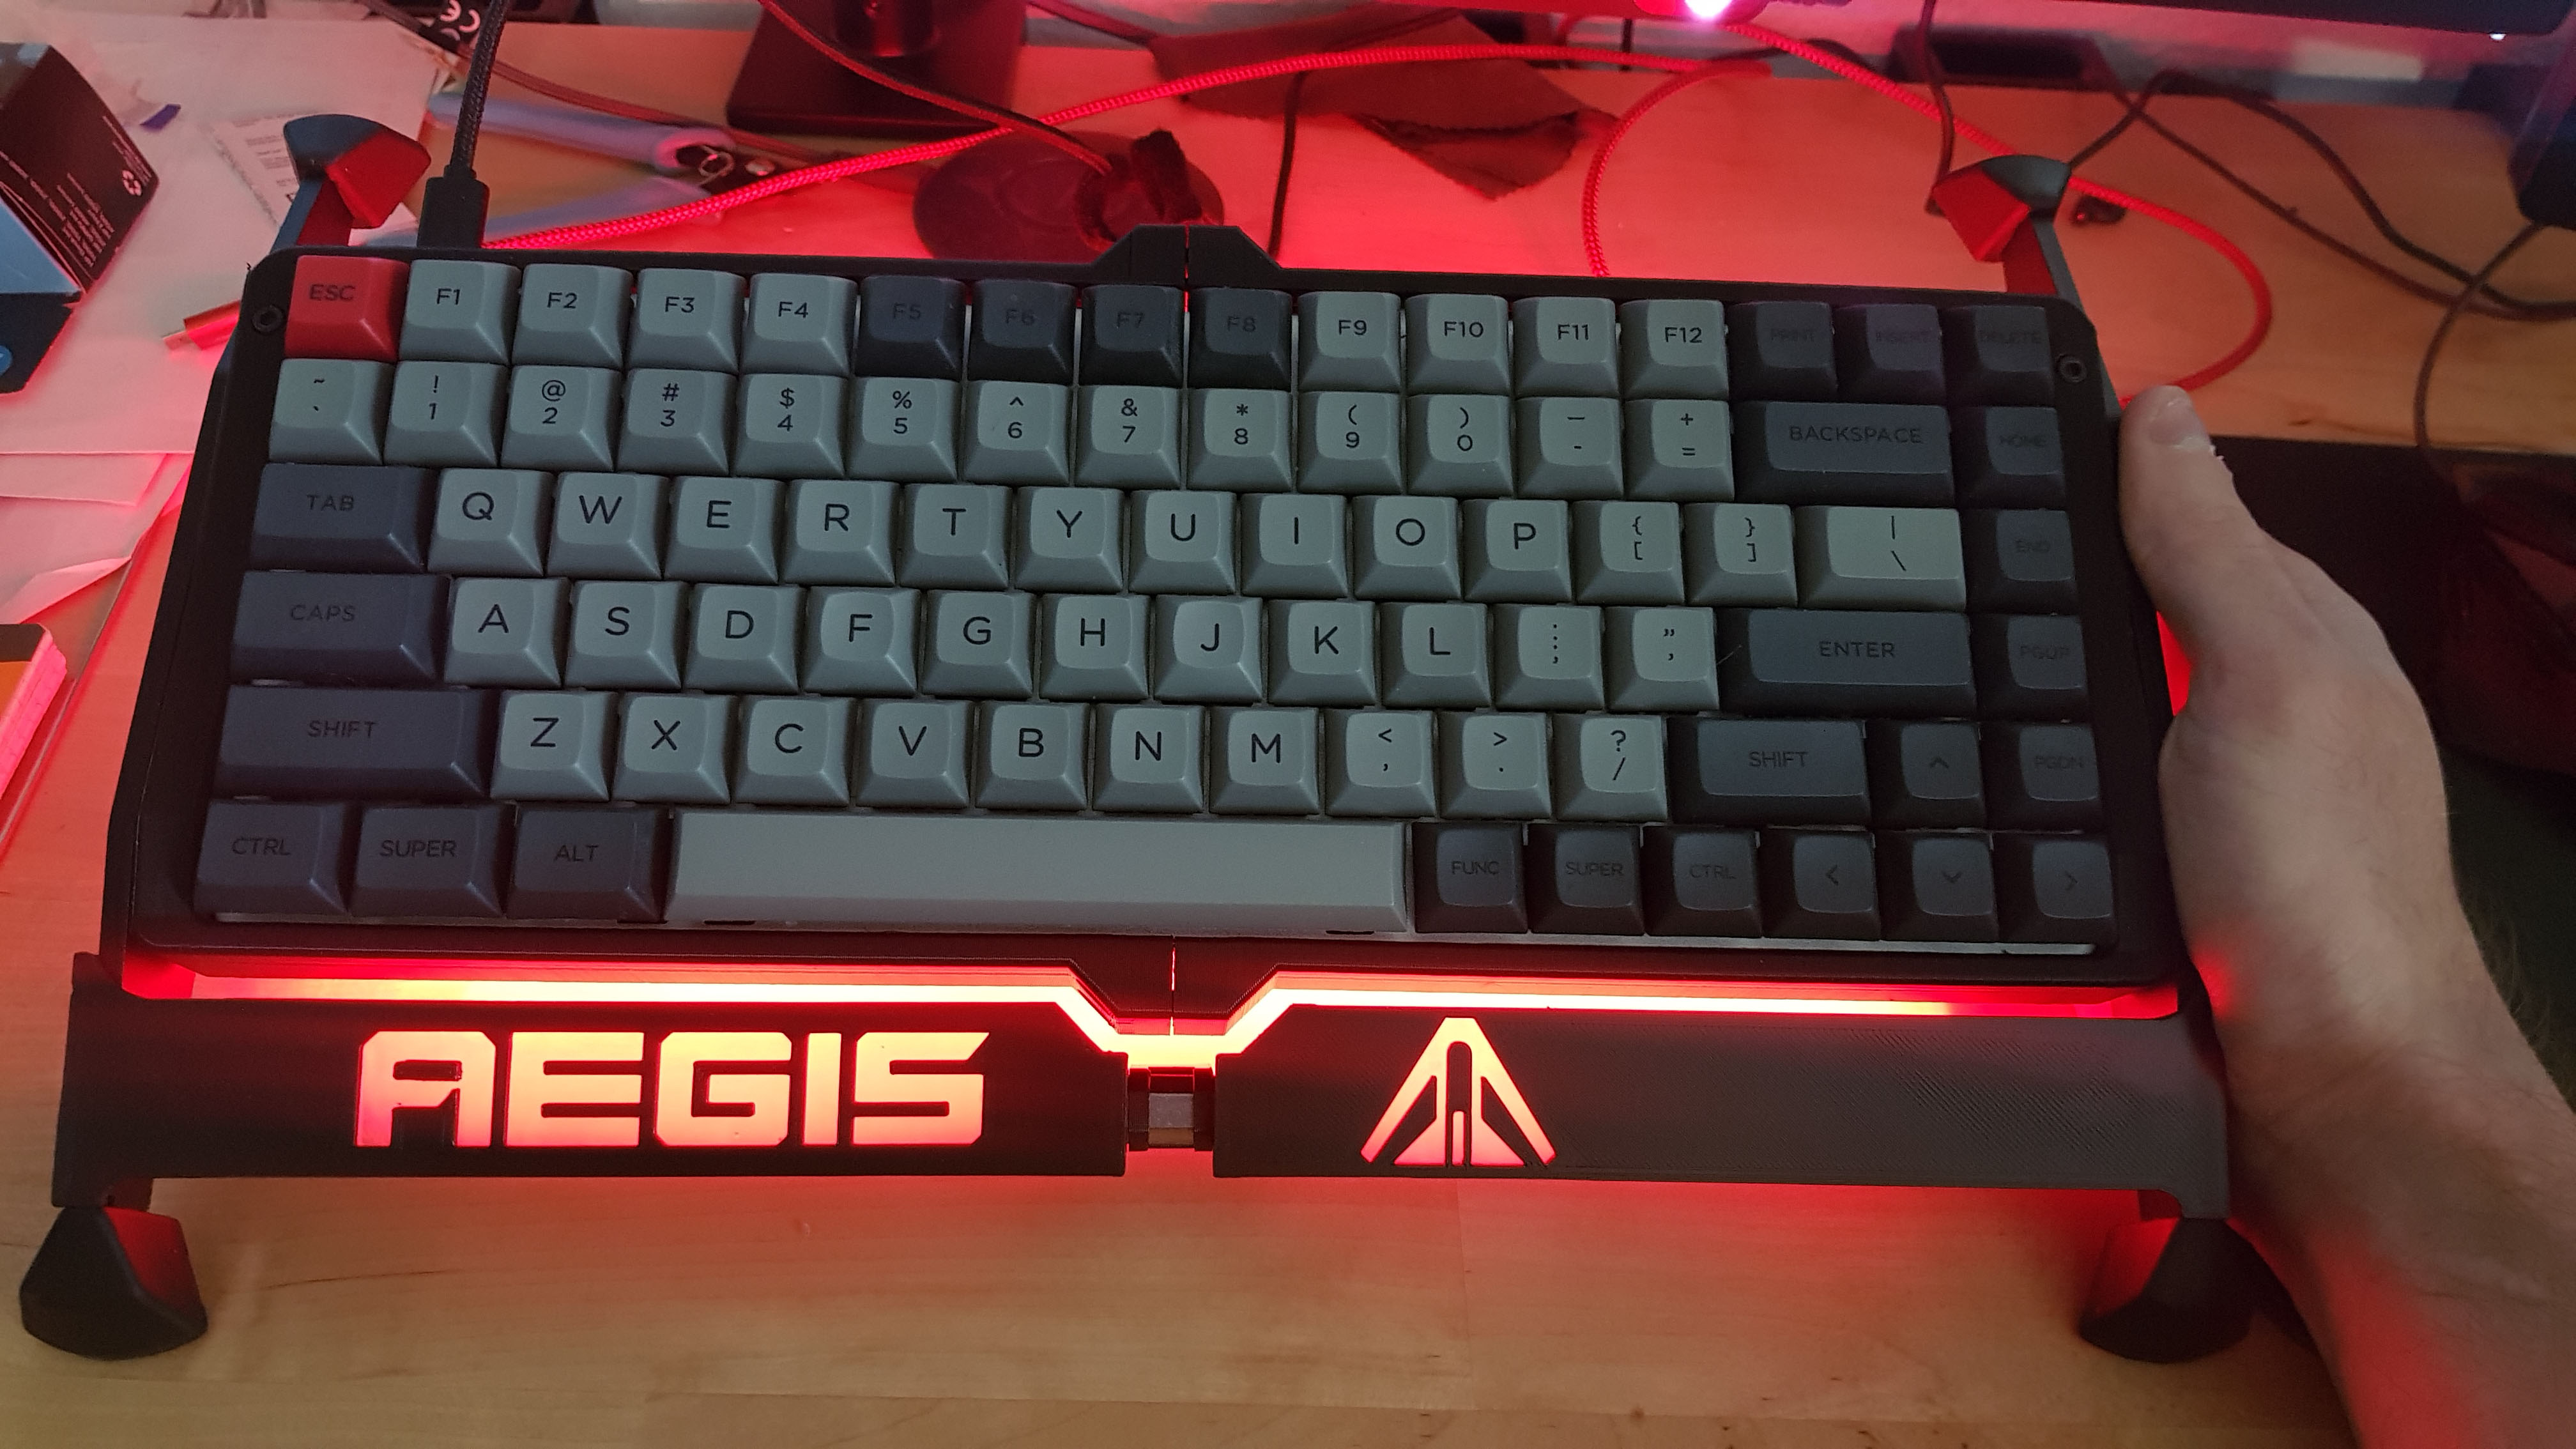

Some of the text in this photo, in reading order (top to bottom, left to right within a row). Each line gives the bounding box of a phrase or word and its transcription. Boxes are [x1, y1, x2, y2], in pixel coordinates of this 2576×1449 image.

[309, 283, 356, 302] ESC
[436, 288, 461, 305] F1
[547, 292, 578, 309] F2
[664, 296, 695, 313] F3
[778, 301, 809, 318] F4
[893, 302, 922, 320] F5
[1005, 308, 1036, 326] F6
[1116, 310, 1145, 328] F7
[1227, 316, 1257, 333] F8
[1338, 319, 1367, 336] F9
[1444, 321, 1484, 338] F10
[1558, 324, 1589, 341] F11
[1664, 326, 1702, 344] F12
[433, 375, 439, 394] !
[541, 379, 566, 402] @
[662, 383, 680, 402] #
[779, 387, 795, 409] $
[892, 390, 912, 410] %
[1121, 398, 1138, 417] &
[429, 402, 437, 420] 1
[542, 406, 558, 424] 2
[660, 410, 676, 427] 3
[1348, 404, 1357, 425] (
[1459, 407, 1469, 429] )
[1680, 413, 1694, 426] +
[777, 414, 793, 432] 4
[893, 417, 908, 434] 5
[1008, 421, 1023, 439] 6
[1122, 425, 1136, 443] 7
[1234, 427, 1248, 445] 8
[1346, 431, 1360, 448] 9
[1789, 425, 1924, 444] BACKSPACE
[1682, 447, 1696, 456] =
[306, 494, 355, 512] TAB
[462, 491, 494, 521] Q
[578, 494, 622, 525] W
[706, 500, 732, 529] E
[824, 503, 850, 532] R
[942, 508, 967, 536] T
[1056, 509, 1083, 539] Y
[1170, 513, 1196, 542] U
[1632, 516, 1643, 536] {
[1745, 517, 1756, 538] }
[1514, 523, 1537, 550] P
[1634, 541, 1643, 561] [
[1746, 542, 1757, 563] ]
[1890, 550, 1906, 572] \
[289, 604, 356, 622] CAPS
[478, 604, 509, 634] A
[604, 606, 630, 636] S
[725, 610, 754, 639] D
[848, 613, 873, 643] F
[963, 616, 992, 645] G
[1080, 618, 1106, 647] H
[1200, 623, 1220, 652] J
[1314, 625, 1339, 655] K
[1429, 627, 1451, 656] L
[1819, 641, 1895, 658] ENTER
[307, 719, 377, 739] SHIFT
[530, 717, 559, 747] Z
[651, 719, 681, 751] X
[774, 723, 804, 754] C
[1378, 728, 1392, 743] <
[898, 726, 927, 756] V
[1018, 727, 1044, 758] B
[1135, 731, 1162, 762] N
[1251, 733, 1281, 763] M
[1493, 732, 1507, 746] >
[1611, 730, 1627, 752] ?
[1612, 757, 1626, 781] /
[1749, 751, 1808, 769] SHIFT
[231, 836, 291, 856] CTRL
[379, 839, 457, 858] SUPER
[554, 844, 599, 862] ALT
[1452, 859, 1500, 877] FUNC
[1566, 861, 1623, 877] SUPER
[1689, 864, 1736, 879] CTRL
[356, 1031, 990, 1148] AEGIS
